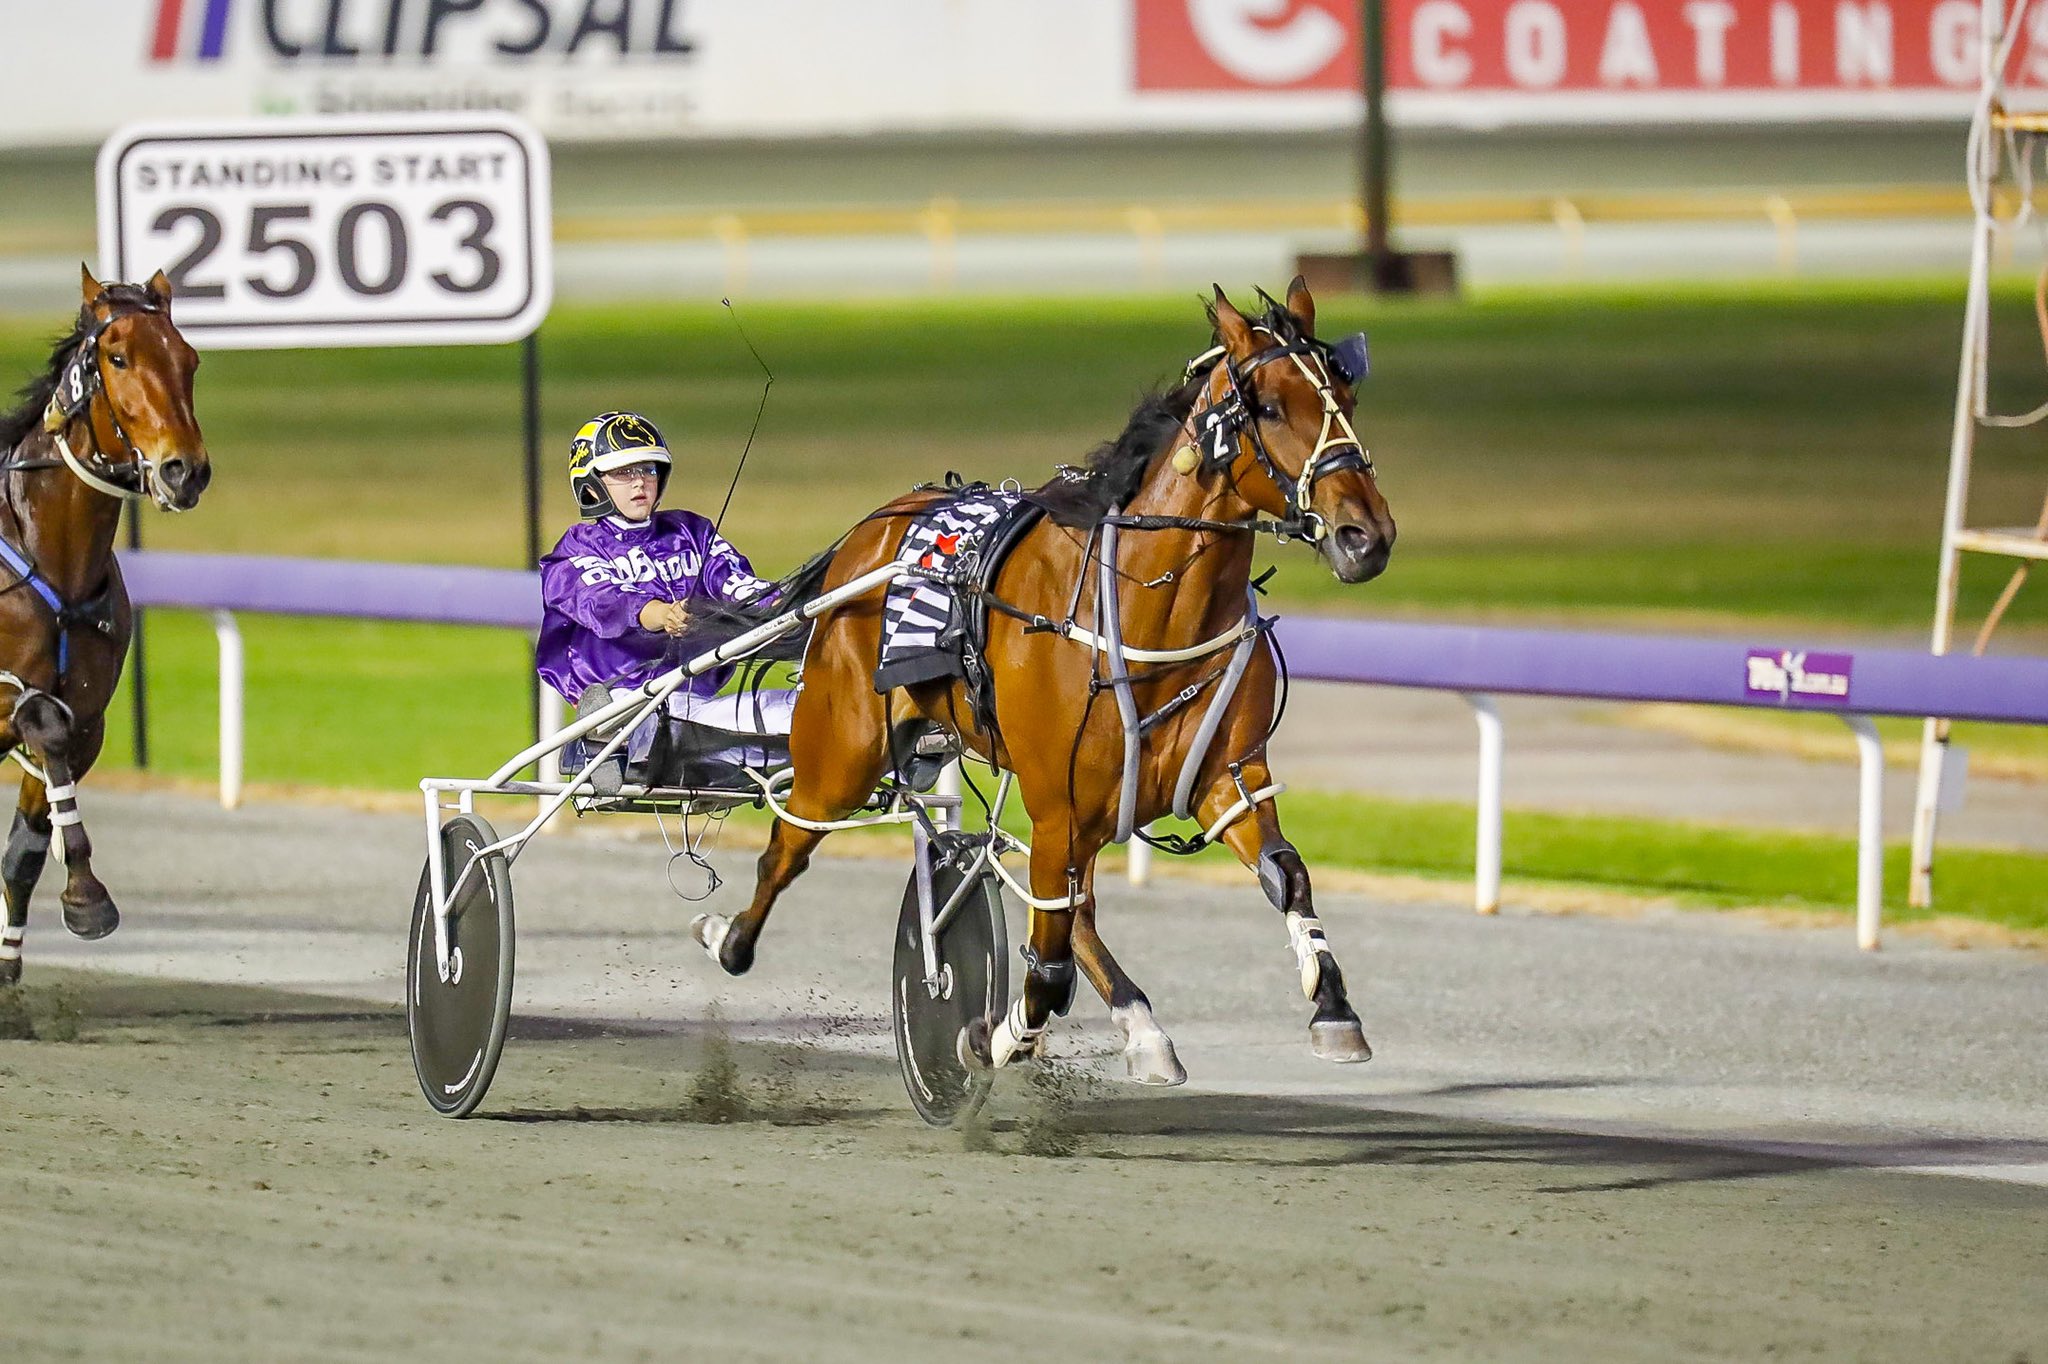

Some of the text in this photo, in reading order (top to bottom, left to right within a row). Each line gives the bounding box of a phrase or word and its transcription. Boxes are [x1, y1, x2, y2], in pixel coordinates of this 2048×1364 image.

[137, 154, 507, 191] STANDING START
[151, 200, 500, 298] 2503
[70, 365, 83, 402] 8
[1206, 413, 1229, 459] 2
